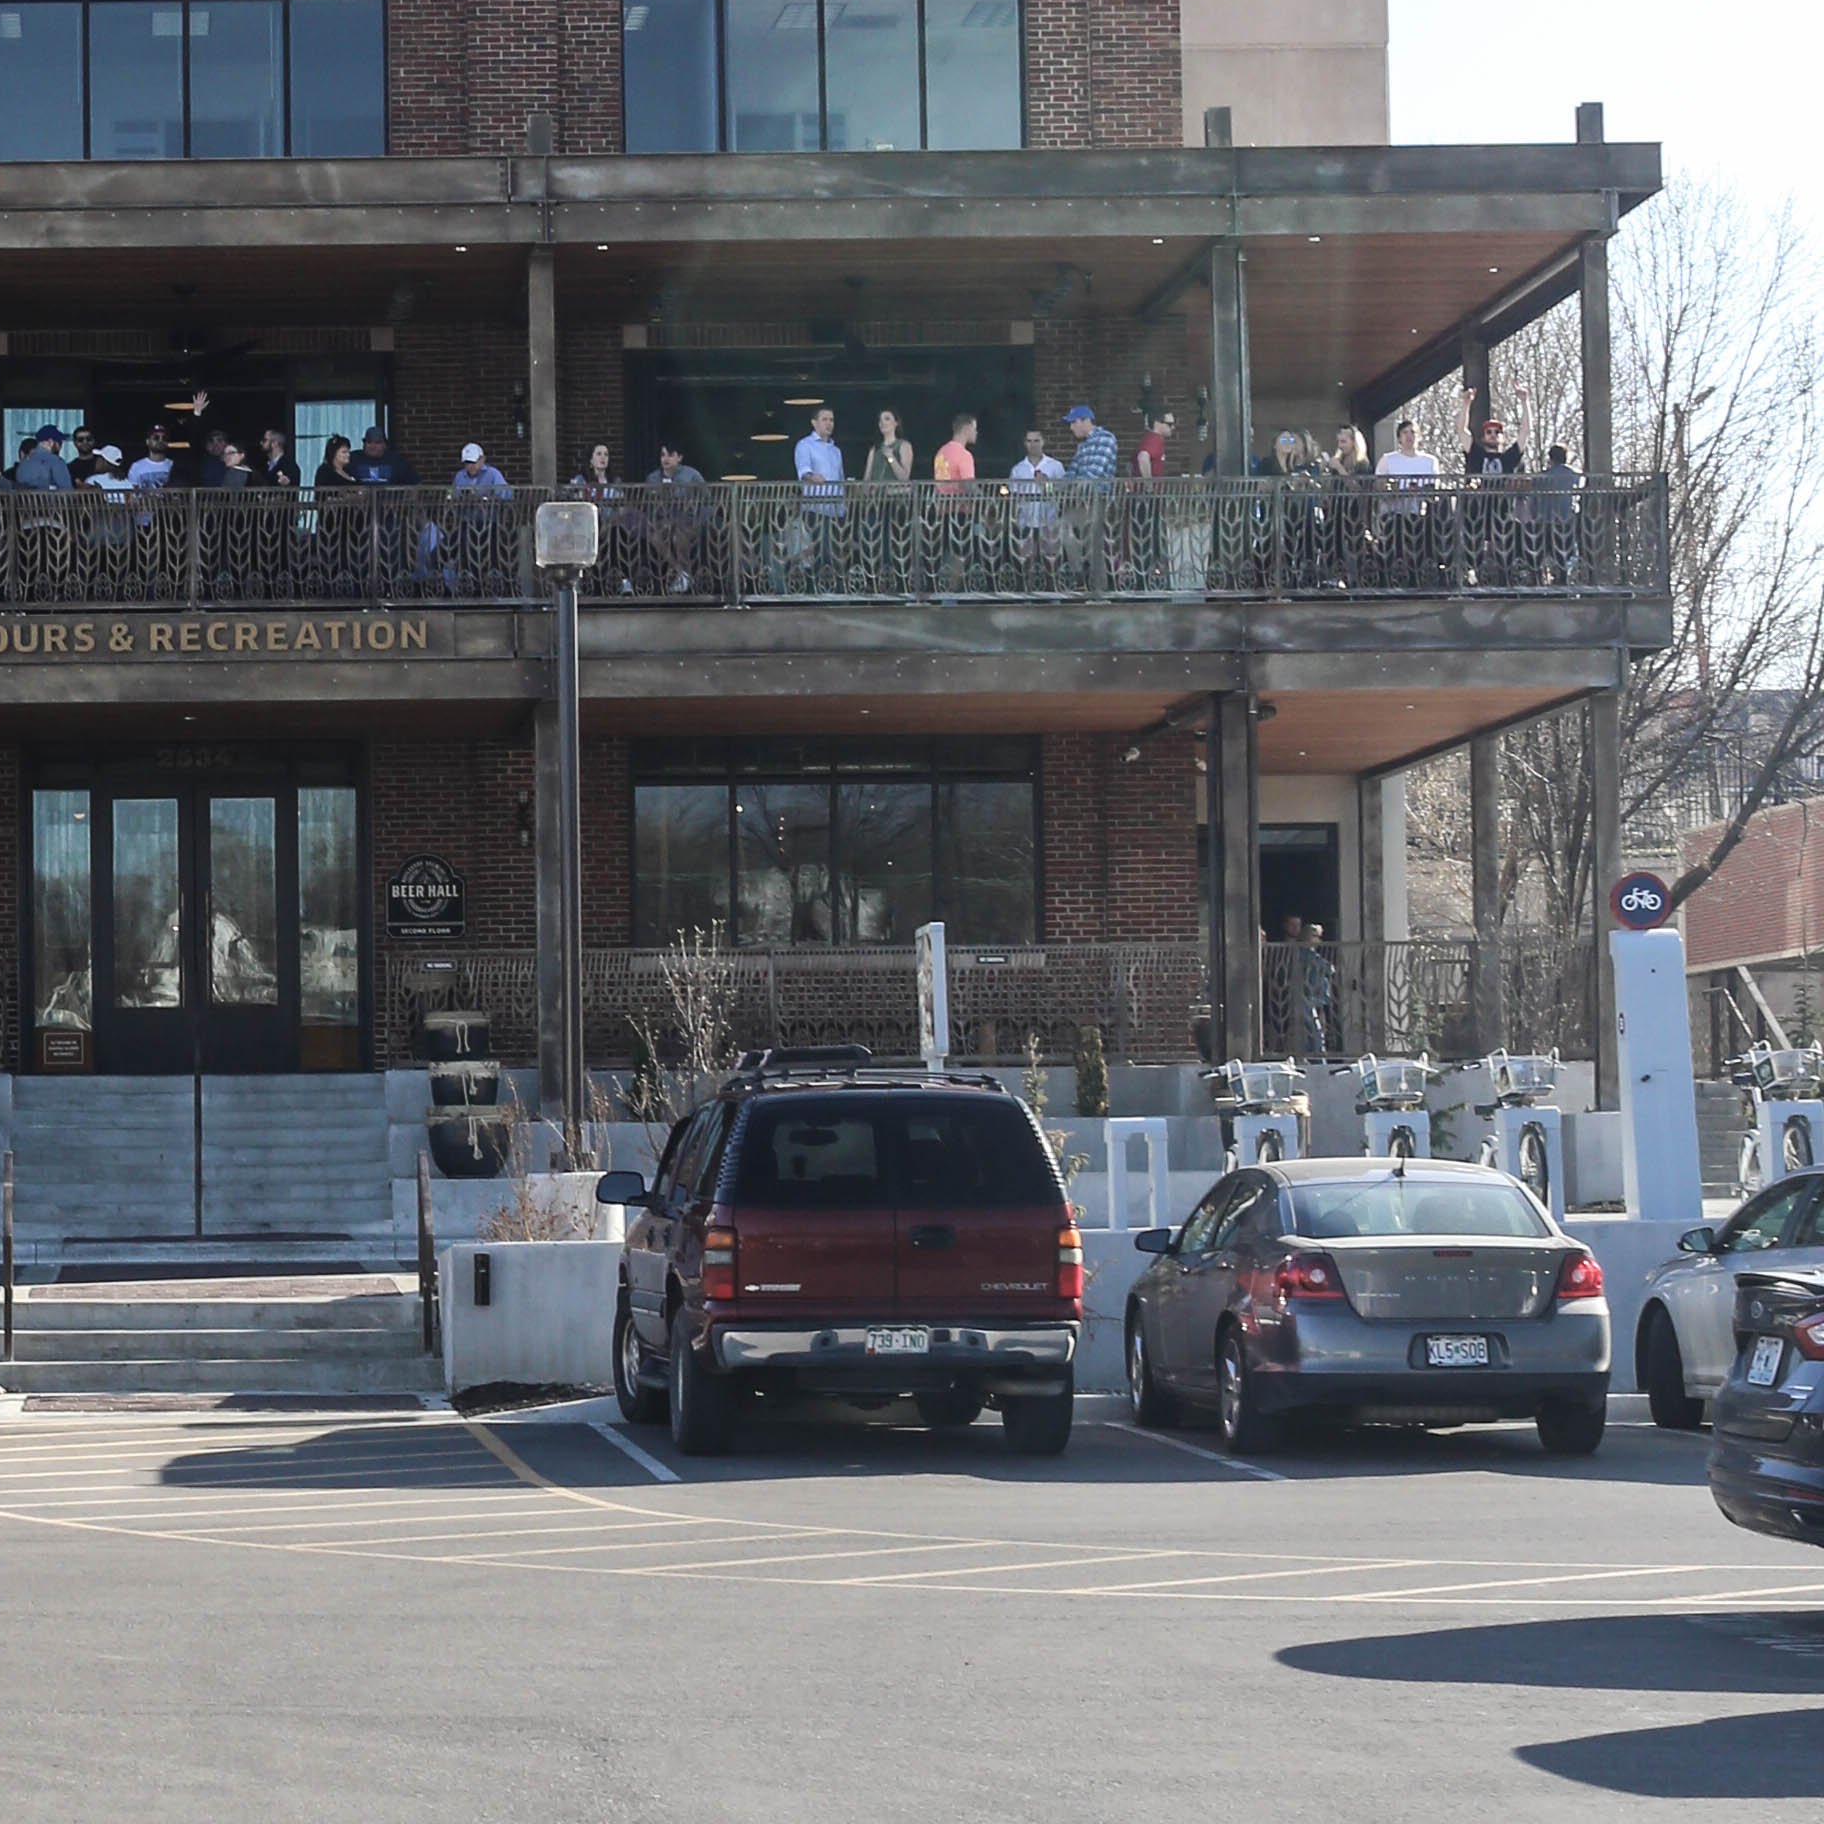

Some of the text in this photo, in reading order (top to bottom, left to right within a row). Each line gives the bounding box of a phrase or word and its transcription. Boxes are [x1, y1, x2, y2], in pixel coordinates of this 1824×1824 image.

[108, 623, 135, 653] &
[148, 619, 428, 653] RECREATION
[391, 884, 459, 898] BEER HALL
